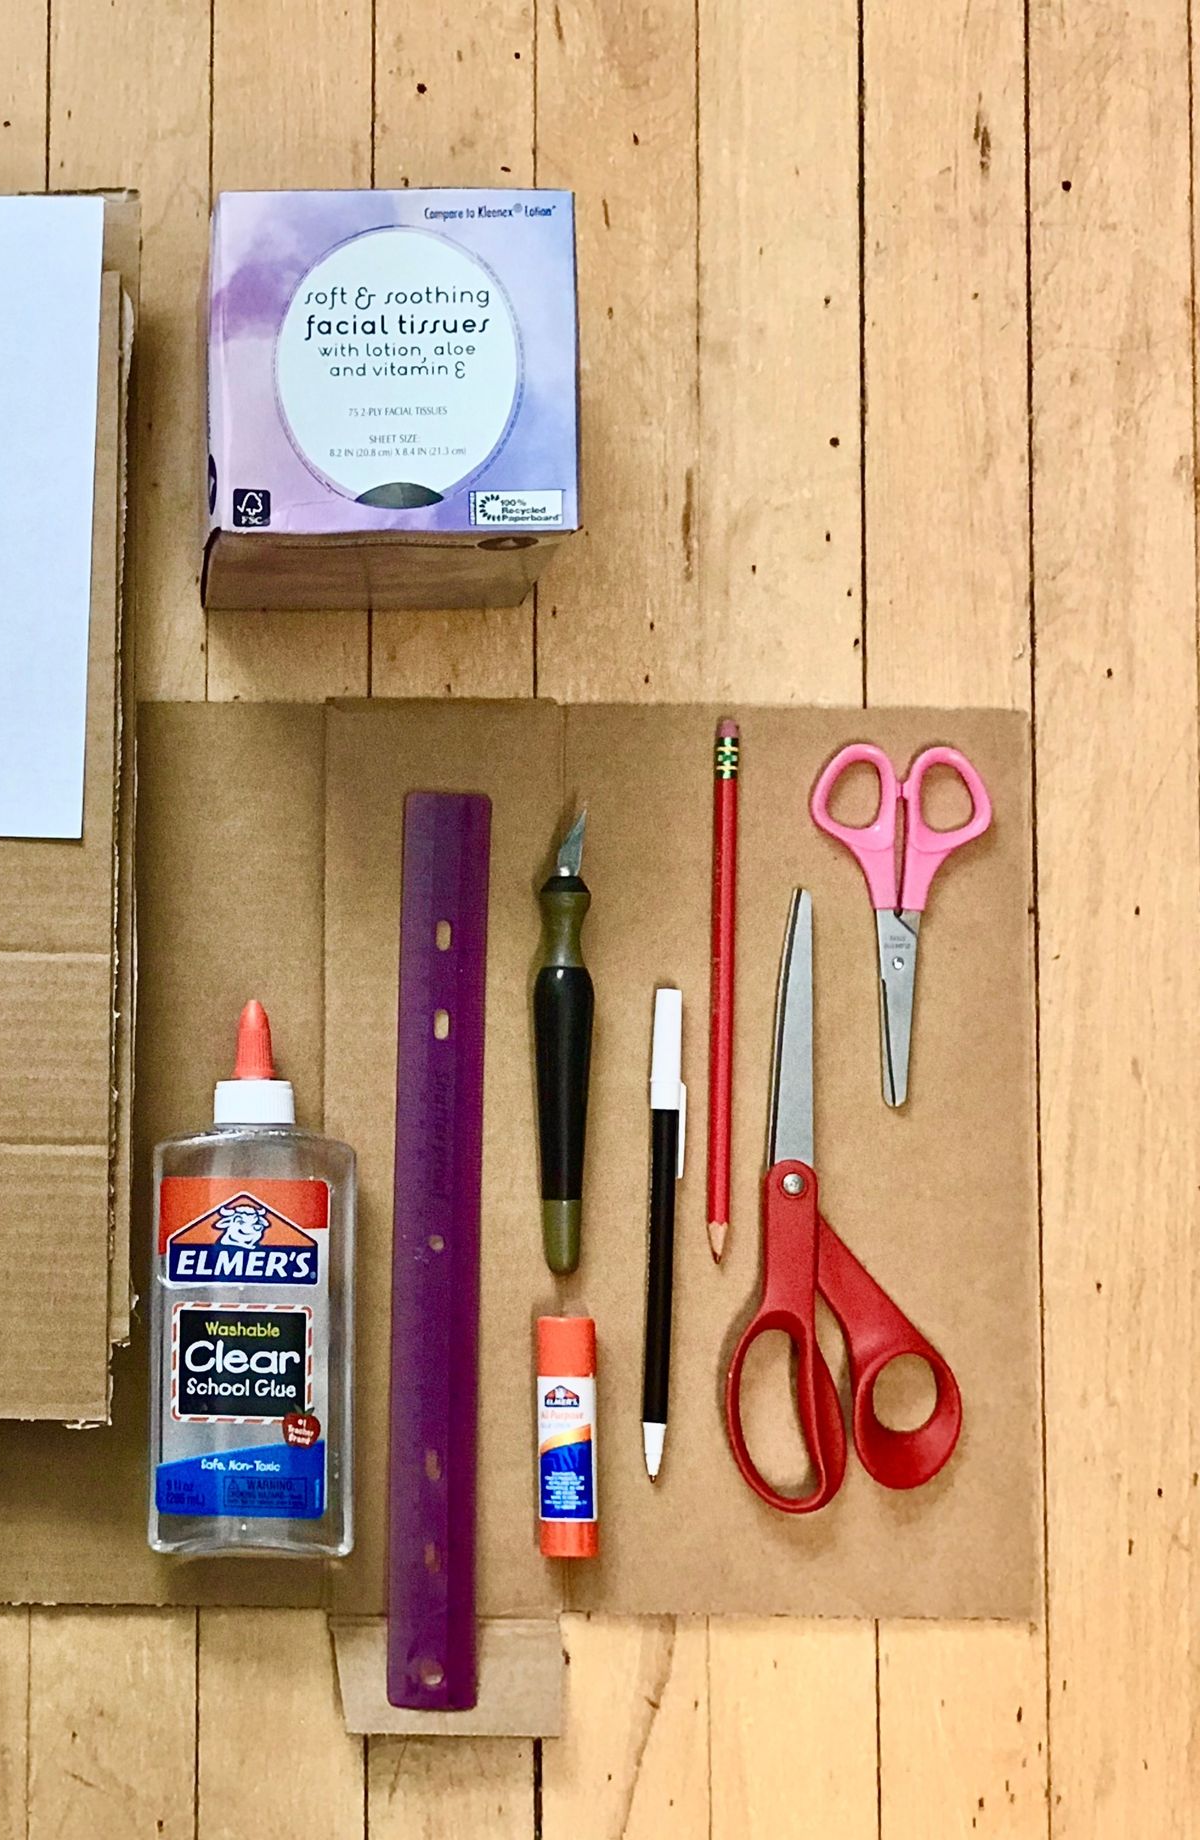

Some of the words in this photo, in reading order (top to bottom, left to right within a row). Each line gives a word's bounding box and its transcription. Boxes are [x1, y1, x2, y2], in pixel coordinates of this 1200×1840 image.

[424, 207, 463, 222] Compare
[466, 208, 475, 218] to
[304, 286, 348, 310] soft
[355, 286, 376, 310] &
[384, 286, 490, 308] soothing
[304, 314, 389, 341] facial
[398, 314, 490, 335] tissues
[318, 343, 359, 357] with
[366, 343, 427, 363] lotion,
[434, 342, 476, 356] aloe
[329, 363, 366, 377] and
[373, 361, 448, 377] vitamin
[454, 360, 466, 379] E
[348, 408, 358, 417] 75
[384, 407, 413, 416] FACIAL
[415, 406, 448, 415] TISSUES
[369, 434, 396, 444] SHEET
[329, 448, 342, 457] 8.2
[344, 448, 354, 457] IN
[356, 448, 376, 458] (20.8
[402, 448, 415, 456] 8.4
[417, 447, 427, 456] IN
[428, 447, 449, 456] (21.3
[451, 447, 467, 456] cm)
[501, 507, 546, 515] Recycled
[502, 514, 559, 522] Paperboard
[241, 516, 263, 525] FSC
[176, 1250, 312, 1278] ELMER'S
[205, 1321, 280, 1338] Washable
[185, 1340, 301, 1375] Clear
[186, 1377, 250, 1397] School
[254, 1379, 297, 1398] Glue
[228, 1460, 281, 1472] Non-Toxic
